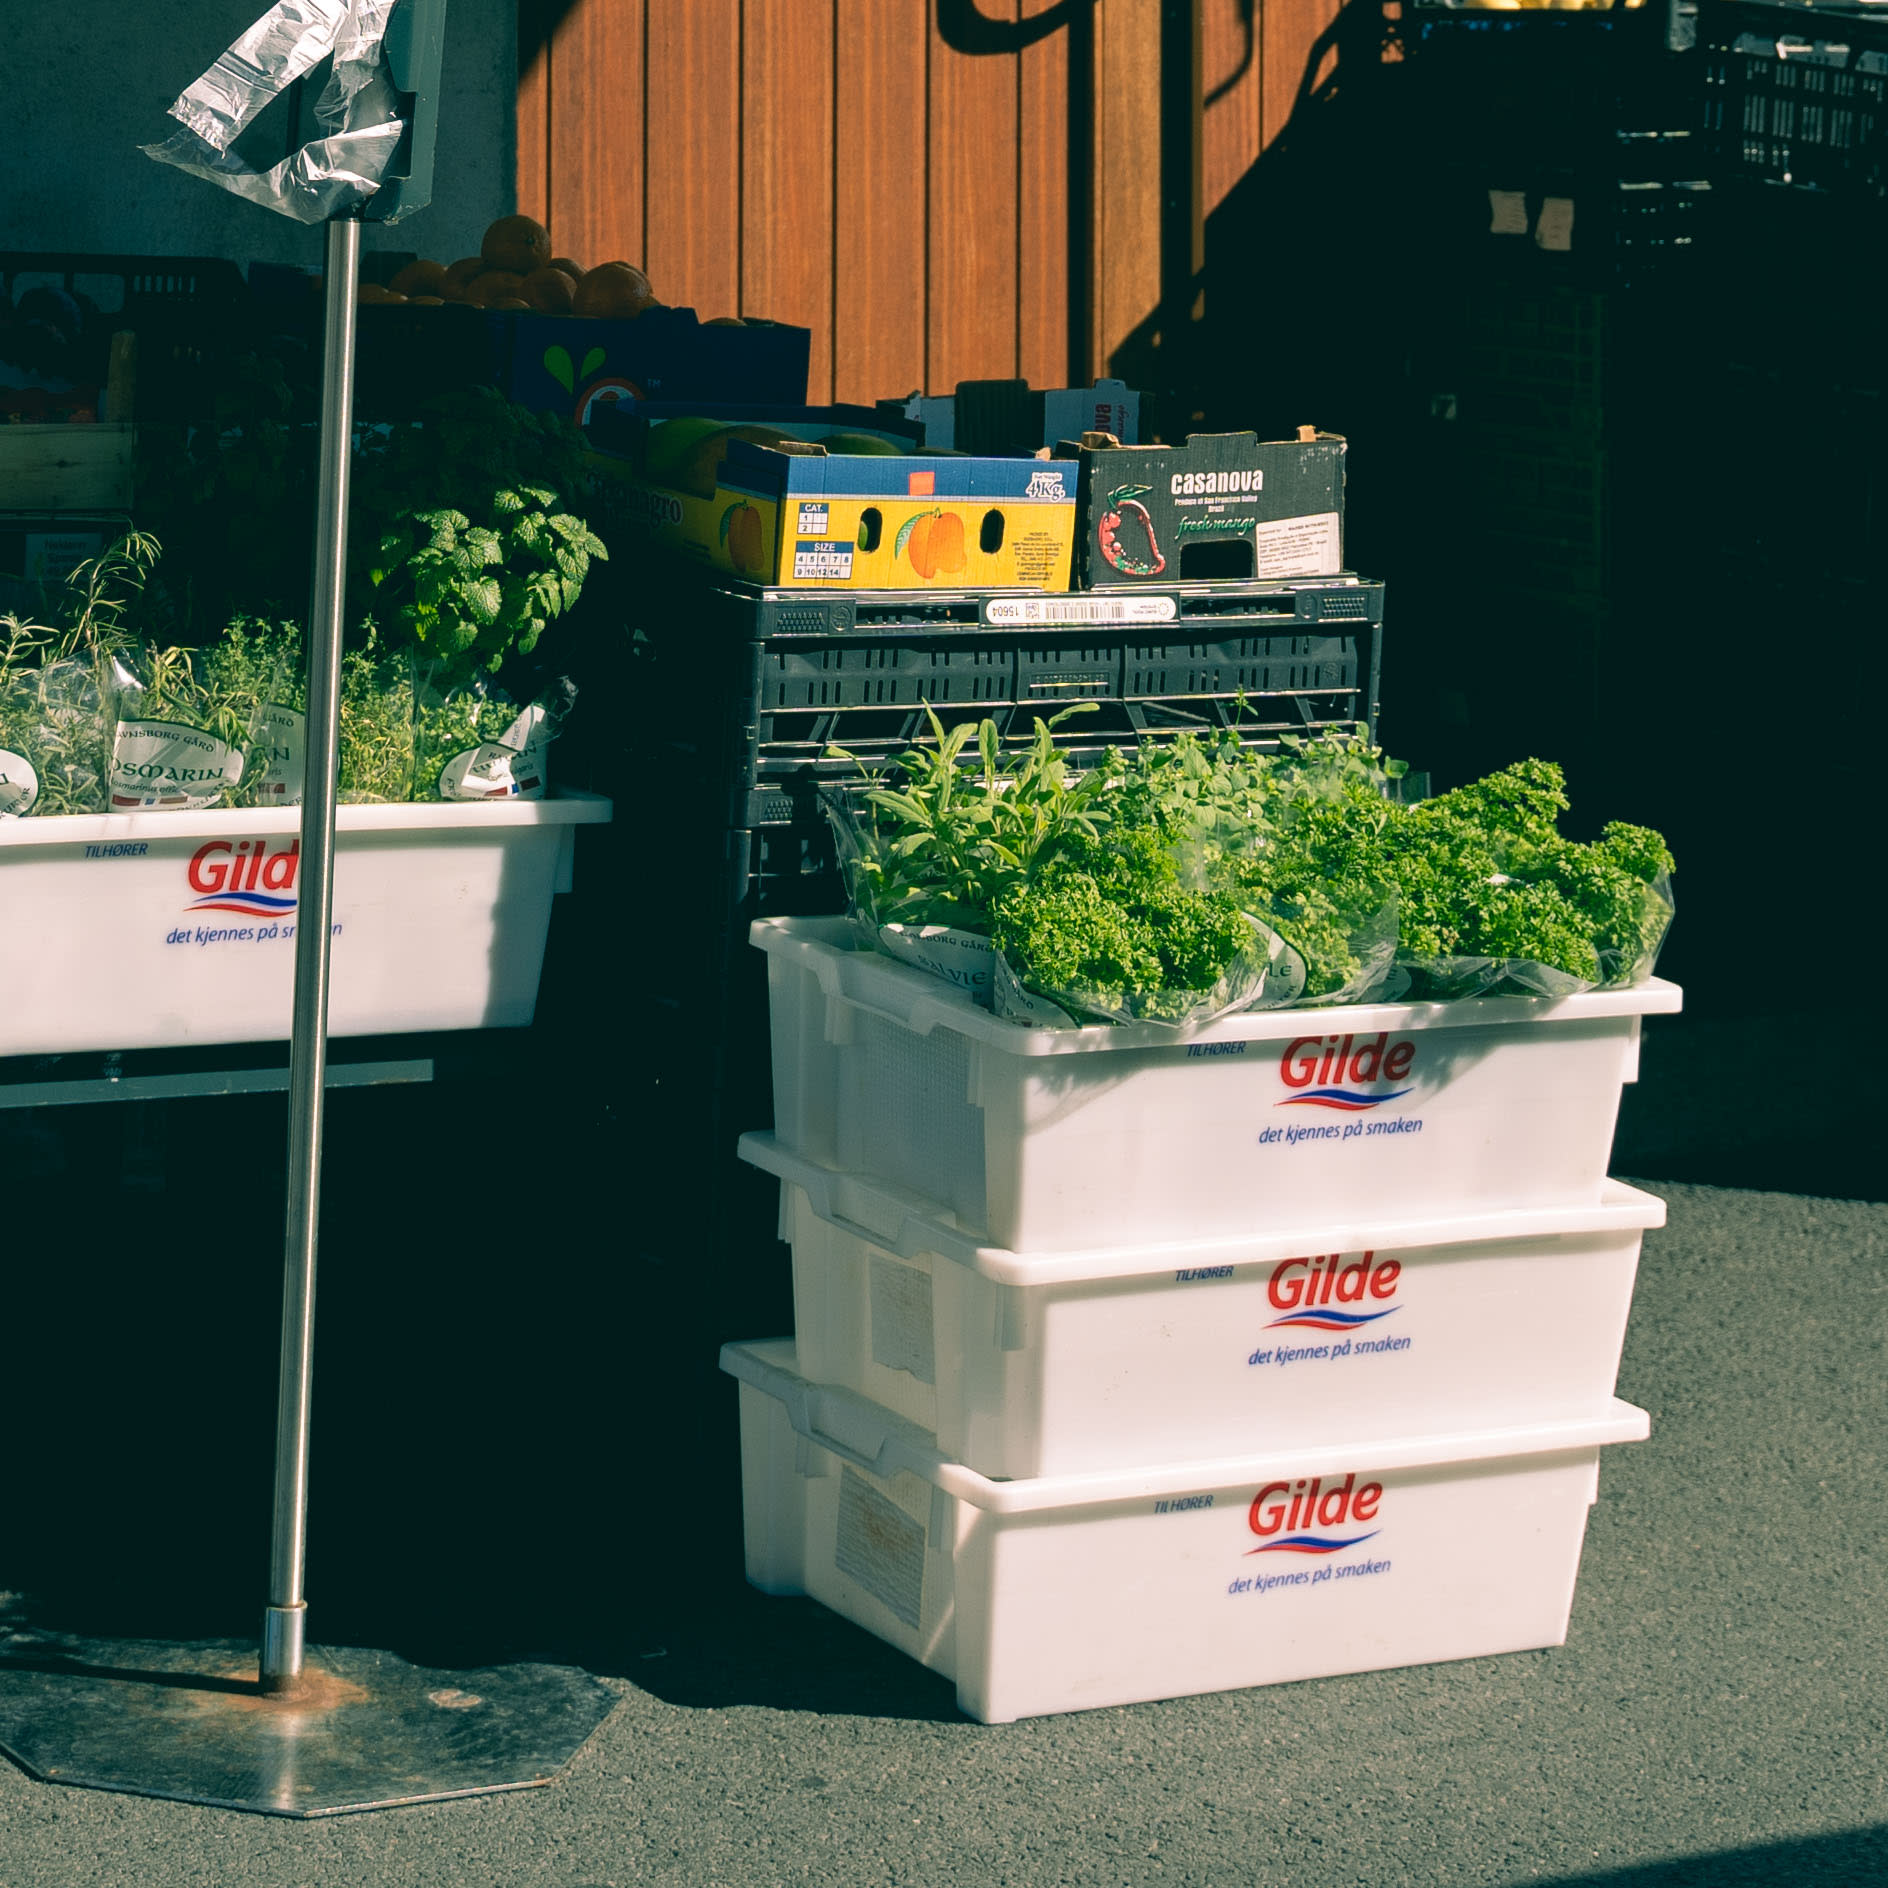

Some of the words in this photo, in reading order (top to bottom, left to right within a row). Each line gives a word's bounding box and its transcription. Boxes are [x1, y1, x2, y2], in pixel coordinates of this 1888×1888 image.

[1170, 469, 1263, 494] casanova
[804, 504, 824, 512] CAT.
[1212, 517, 1256, 536] mango
[814, 542, 836, 552] SIZE
[797, 568, 802, 576] 9
[807, 568, 816, 576] 10
[817, 568, 827, 576] 12
[829, 568, 839, 576] 14
[85, 843, 149, 859] TILHØRER
[187, 839, 301, 894] Gild
[167, 923, 193, 945] det
[195, 924, 254, 947] kjennes
[257, 918, 278, 941] på
[1187, 1041, 1246, 1057] TILHØRER
[1279, 1032, 1416, 1087] Gilde
[1258, 1126, 1282, 1144] det
[1285, 1124, 1340, 1145] kjennes
[1342, 1119, 1363, 1140] på
[1366, 1117, 1423, 1136] smaken
[1175, 1265, 1234, 1282] TILHØRER
[1267, 1251, 1402, 1309] Gilde
[1248, 1348, 1272, 1366] det
[1275, 1345, 1328, 1366] kjennes
[1331, 1339, 1351, 1360] på
[1354, 1335, 1411, 1354] smaken
[1154, 1495, 1214, 1514] TILHØRER
[1248, 1473, 1383, 1536] Gilde
[1228, 1577, 1252, 1594] det
[1255, 1572, 1309, 1594] kjennes
[1312, 1566, 1332, 1585] på
[1335, 1558, 1391, 1579] smaken
